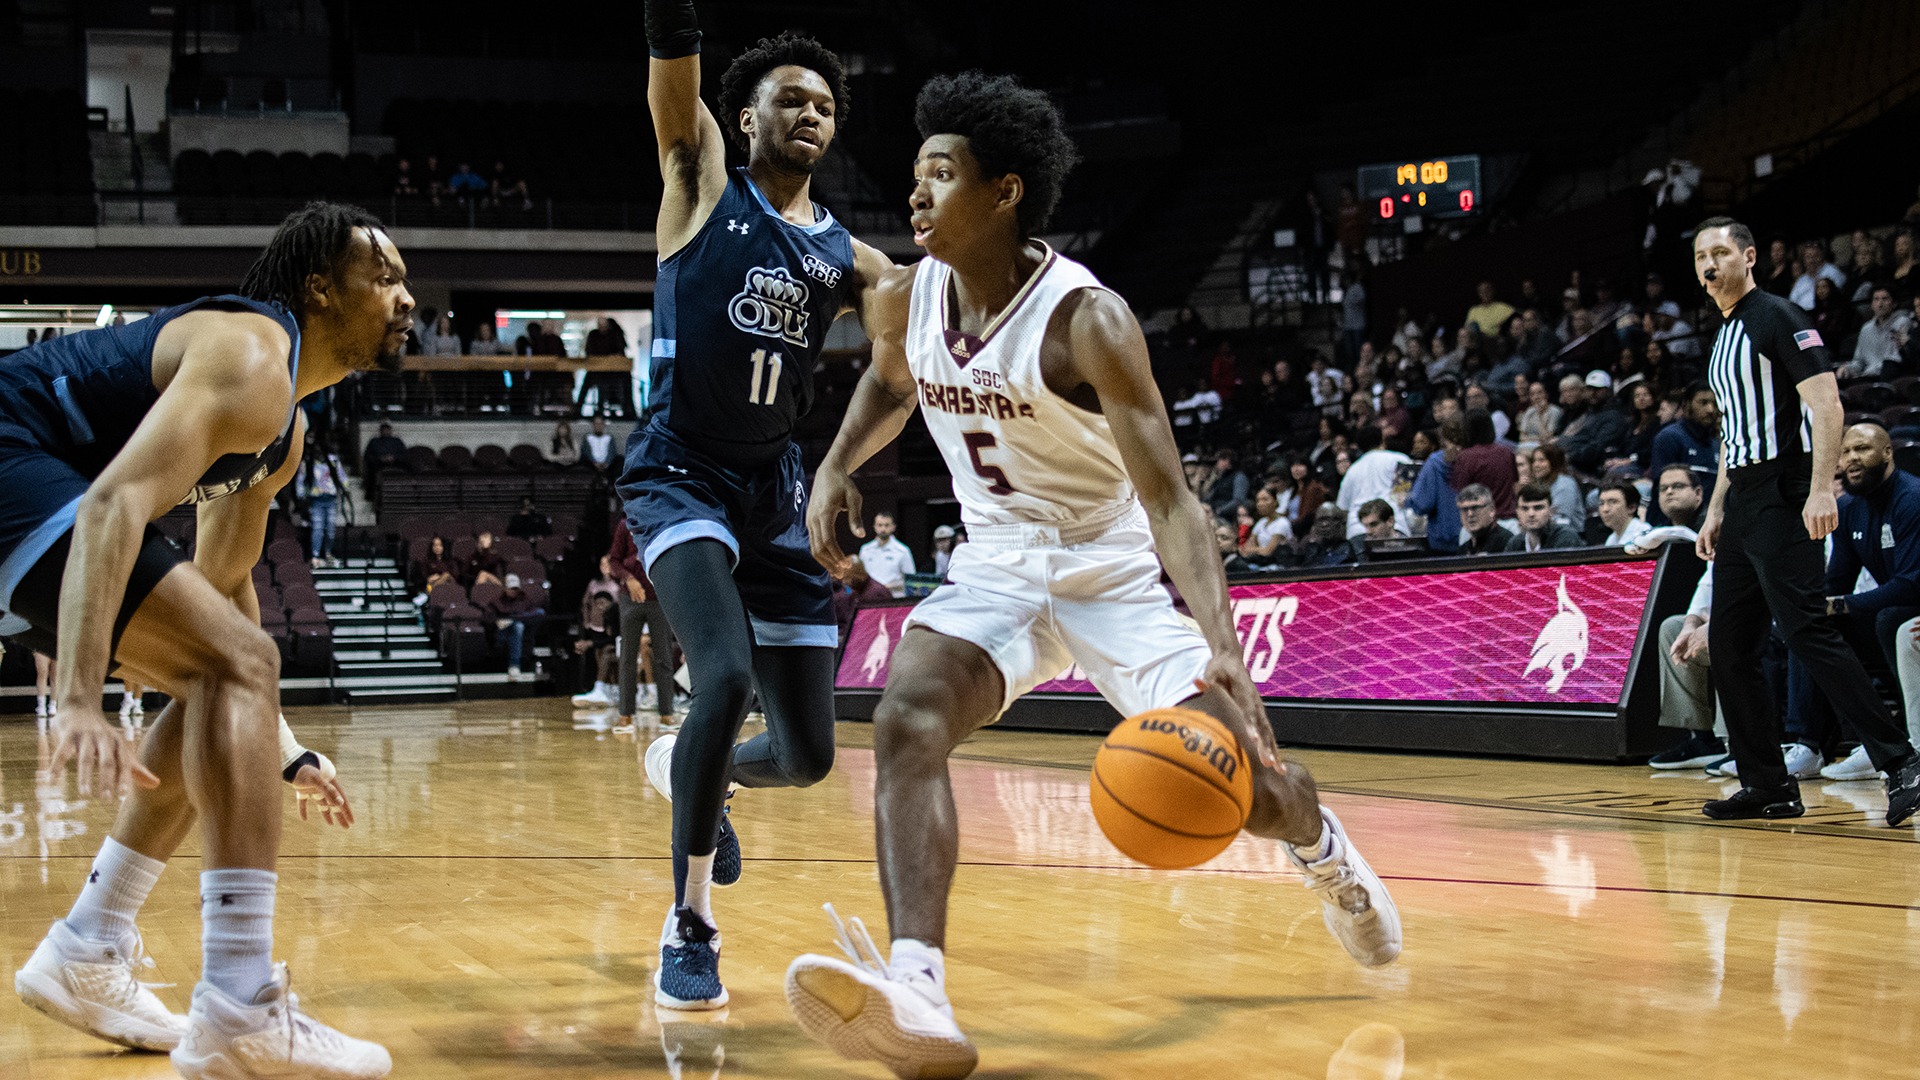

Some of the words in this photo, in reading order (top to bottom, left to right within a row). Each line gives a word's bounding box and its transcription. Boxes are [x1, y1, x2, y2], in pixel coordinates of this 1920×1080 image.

[1380, 196, 1395, 219] 0
[802, 254, 842, 289] SBC
[731, 296, 808, 346] ODU
[749, 348, 782, 405] 11
[918, 377, 976, 415] TEXAS
[972, 367, 1001, 389] SBC
[961, 430, 1015, 496] 5
[1139, 719, 1237, 784] Wilson
